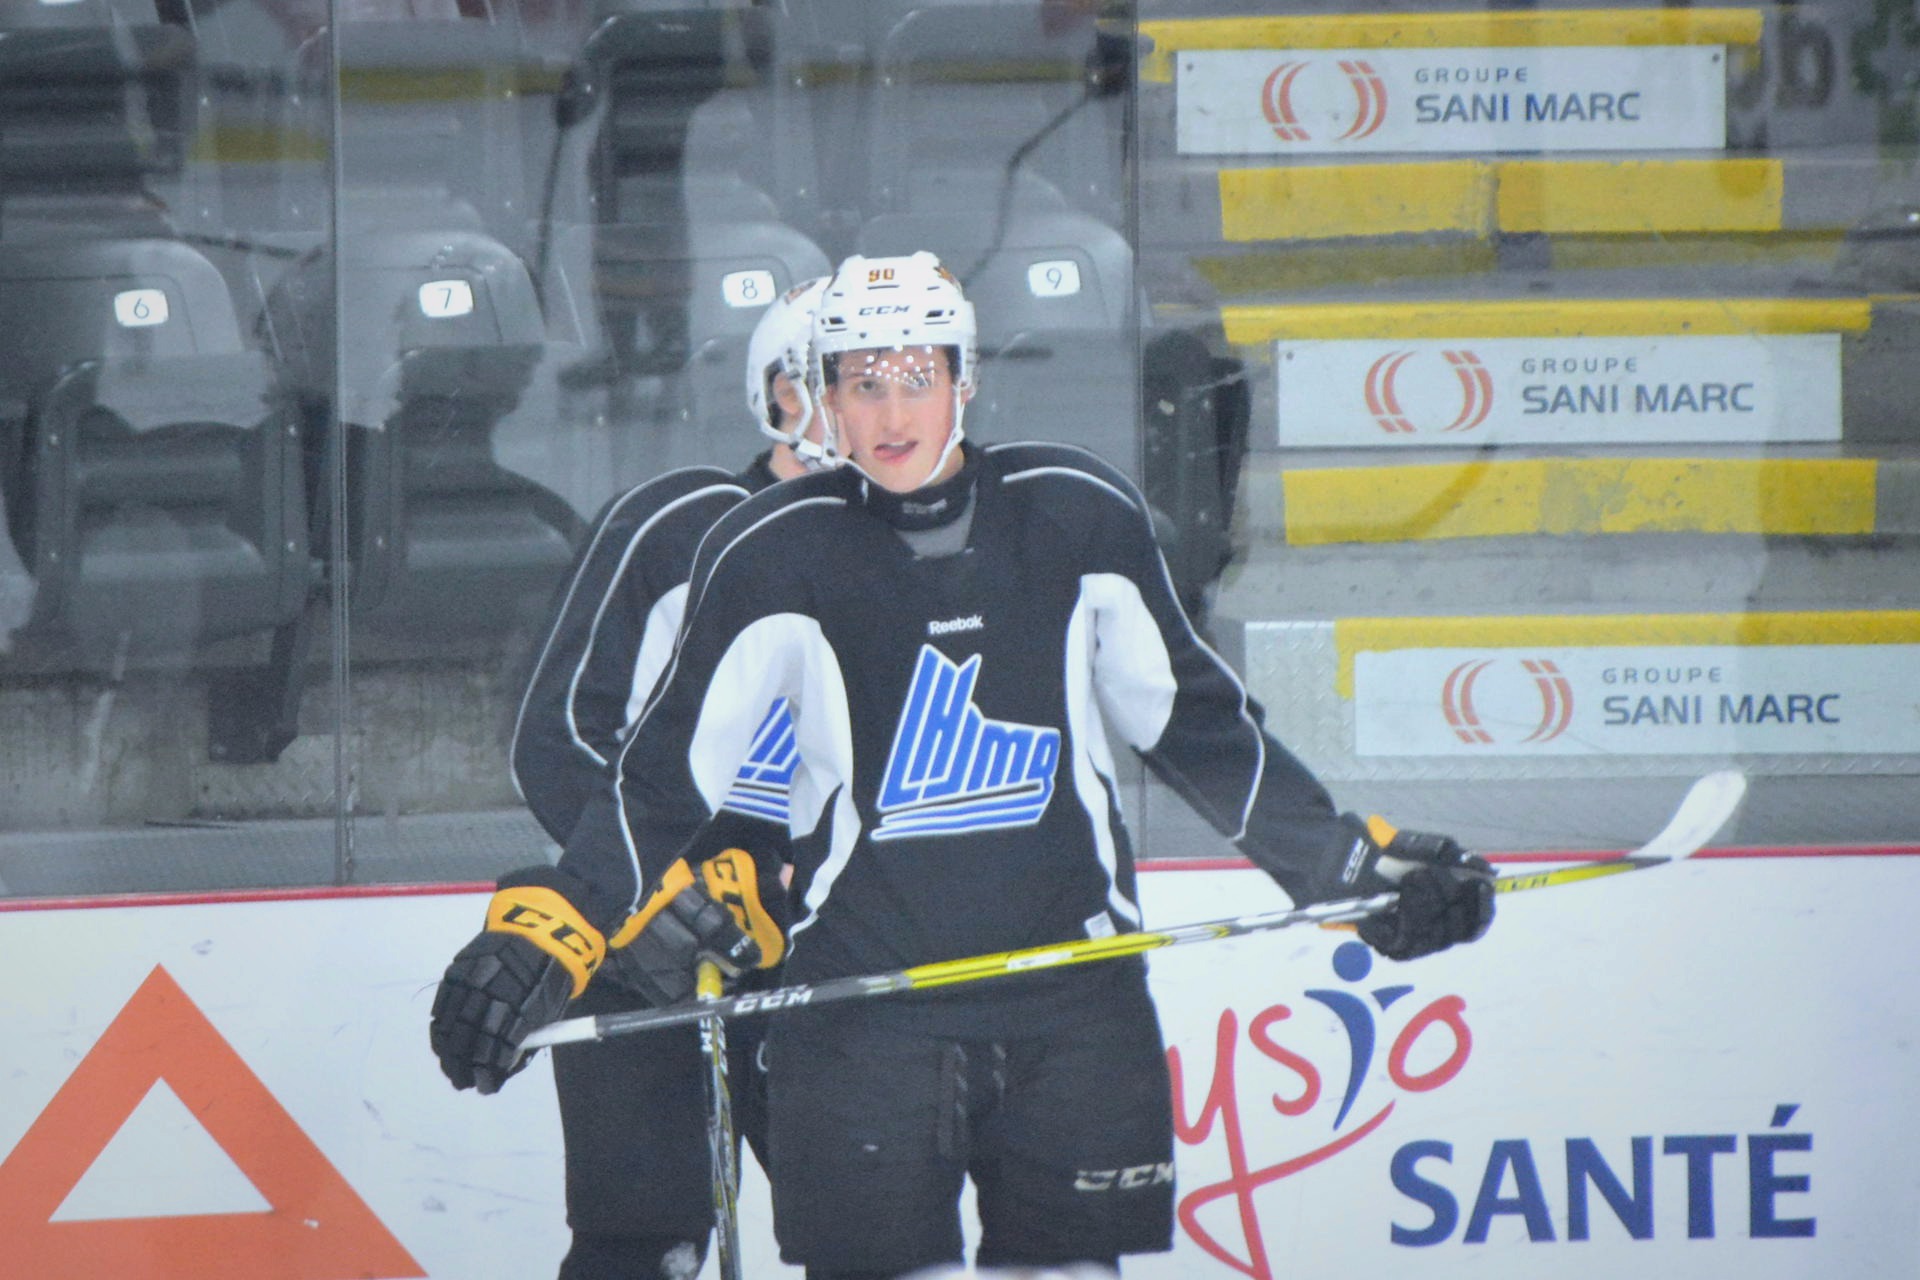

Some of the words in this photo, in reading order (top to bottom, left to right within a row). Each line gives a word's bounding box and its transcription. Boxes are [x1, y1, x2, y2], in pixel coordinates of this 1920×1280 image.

[1415, 67, 1528, 83] GROUPE
[1415, 93, 1510, 123] SANI
[1525, 91, 1641, 122] MARC
[867, 268, 895, 283] 90
[1046, 268, 1063, 291] 9
[439, 287, 454, 311] 7
[742, 277, 758, 300] 8
[133, 297, 150, 320] 6
[858, 305, 910, 317] CCM
[1521, 357, 1638, 374] GROUPE
[1522, 384, 1618, 414] SANI
[1635, 382, 1755, 413] MARC
[927, 614, 985, 635] Reebok
[1602, 667, 1723, 684] GROUPE
[1603, 694, 1702, 725] SANI
[1718, 693, 1841, 724] MARC
[502, 903, 597, 969] CC
[734, 989, 814, 1014] CCM
[1390, 1104, 1817, 1248] SANTÉ
